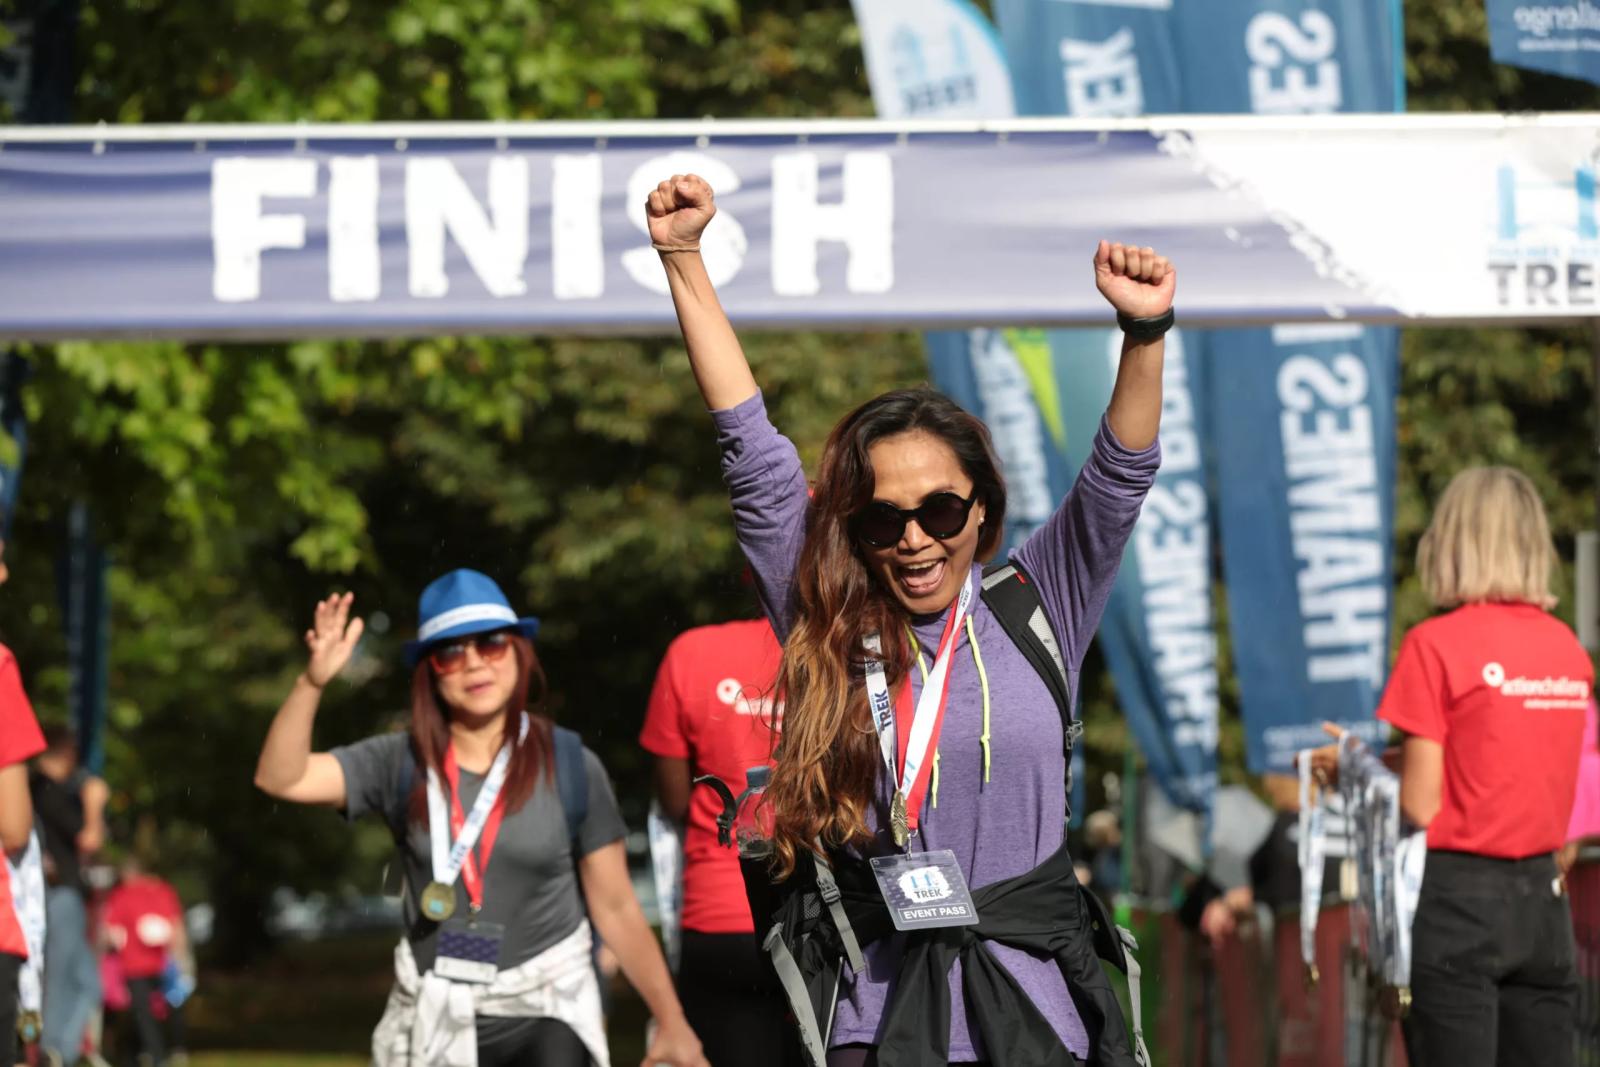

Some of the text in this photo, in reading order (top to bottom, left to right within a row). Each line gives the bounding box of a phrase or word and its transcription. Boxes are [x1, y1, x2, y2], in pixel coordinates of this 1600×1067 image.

[211, 151, 894, 301] FINISH
[1487, 262, 1597, 306] TRE
[875, 690, 893, 731] TREK
[904, 906, 967, 919] EVENT PASS
[914, 889, 943, 899] TREK
